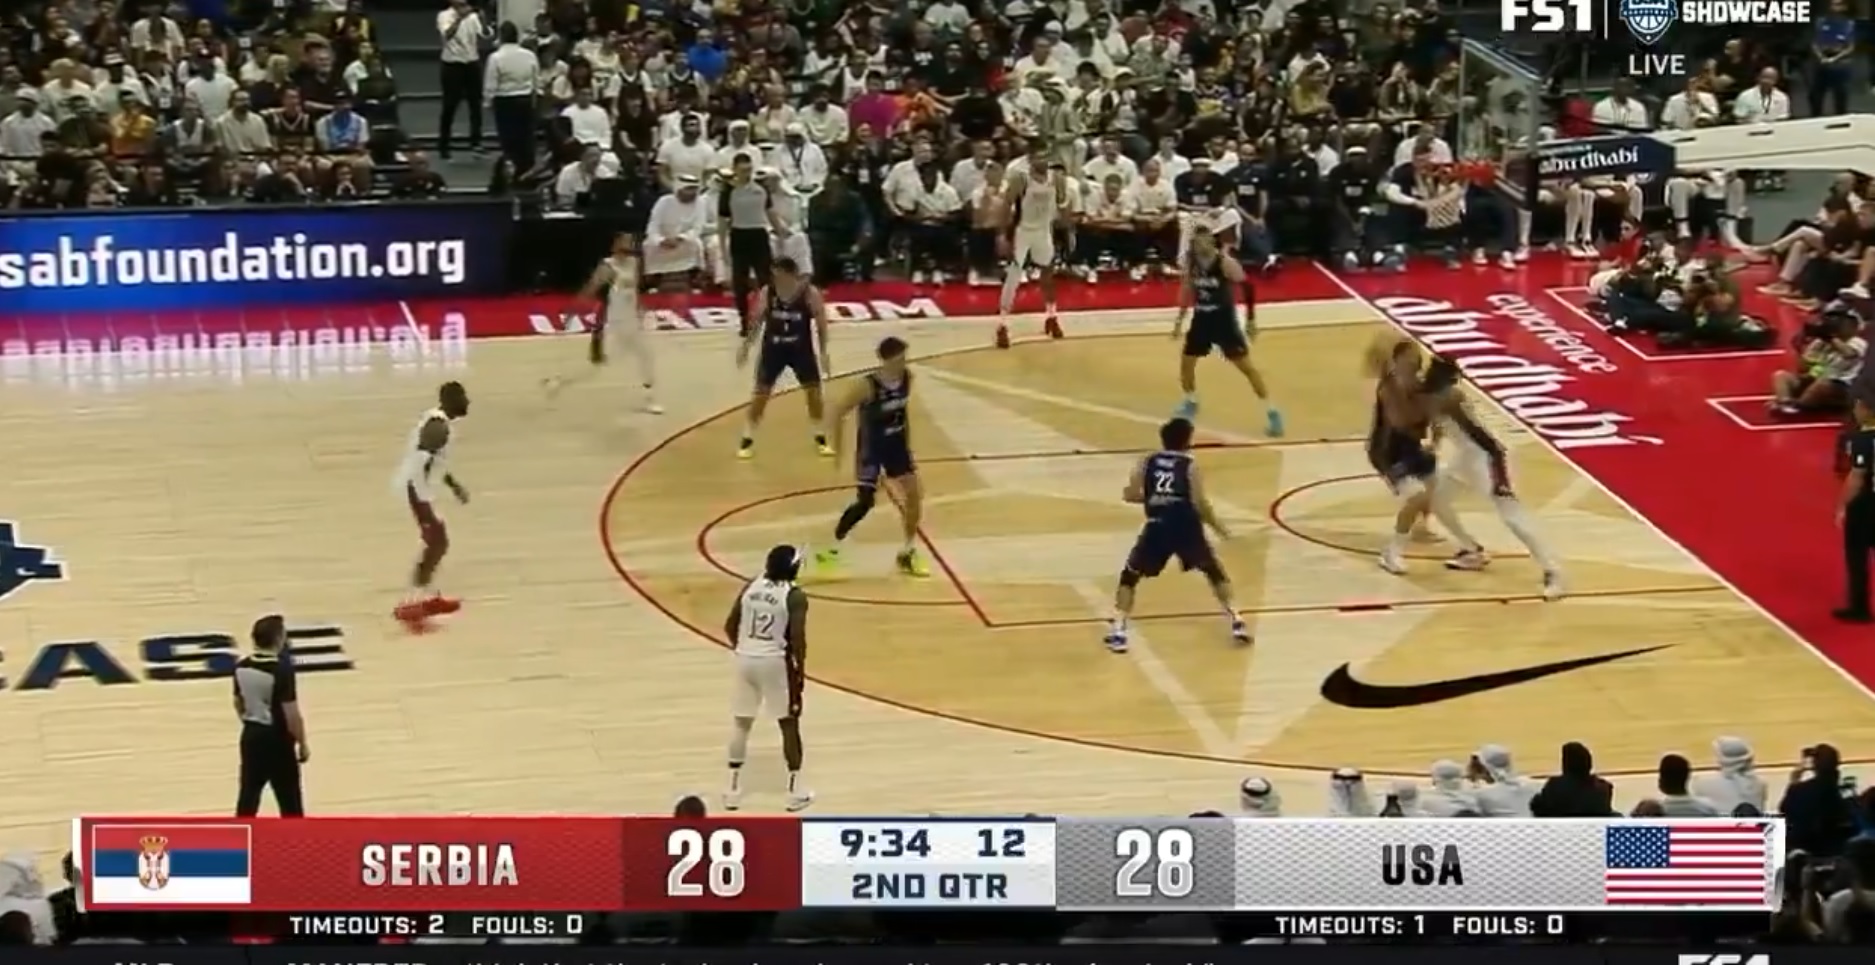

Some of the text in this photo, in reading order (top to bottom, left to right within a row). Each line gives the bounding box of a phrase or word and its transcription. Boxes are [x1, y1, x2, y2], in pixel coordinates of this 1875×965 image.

[1580, 145, 1640, 169] dhabi
[0, 231, 465, 289] sabfoundation.org
[1485, 293, 1618, 374] experience
[1374, 296, 1665, 450] abu dhabi
[1154, 470, 1176, 494] 22
[748, 608, 775, 641] 12
